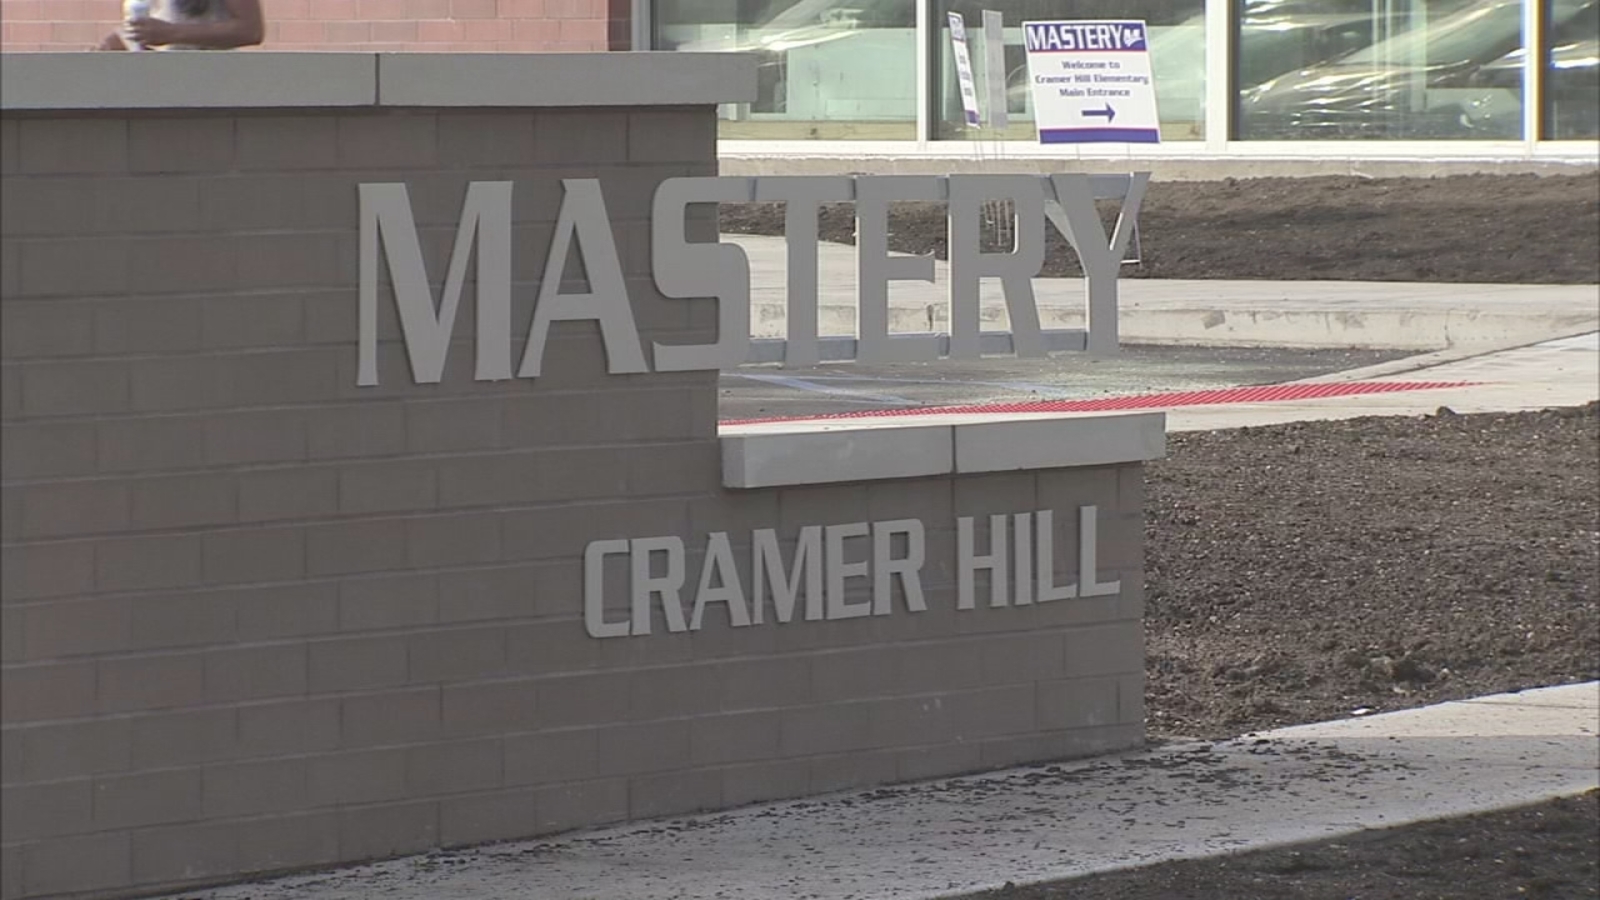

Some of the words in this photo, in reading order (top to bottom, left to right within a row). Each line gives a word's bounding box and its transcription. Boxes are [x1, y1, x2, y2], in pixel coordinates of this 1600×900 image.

[1027, 24, 1123, 50] MASTERY
[1062, 60, 1107, 69] Welcome
[1109, 60, 1120, 69] to
[1035, 75, 1071, 84] Cramer
[1074, 74, 1091, 83] Hill
[1094, 74, 1149, 85] Elementary
[1060, 88, 1085, 97] Main
[1087, 88, 1130, 97] Entrance
[355, 172, 1151, 386] MASTERY
[584, 518, 927, 638] CRAMER
[957, 505, 1121, 610] HILL
